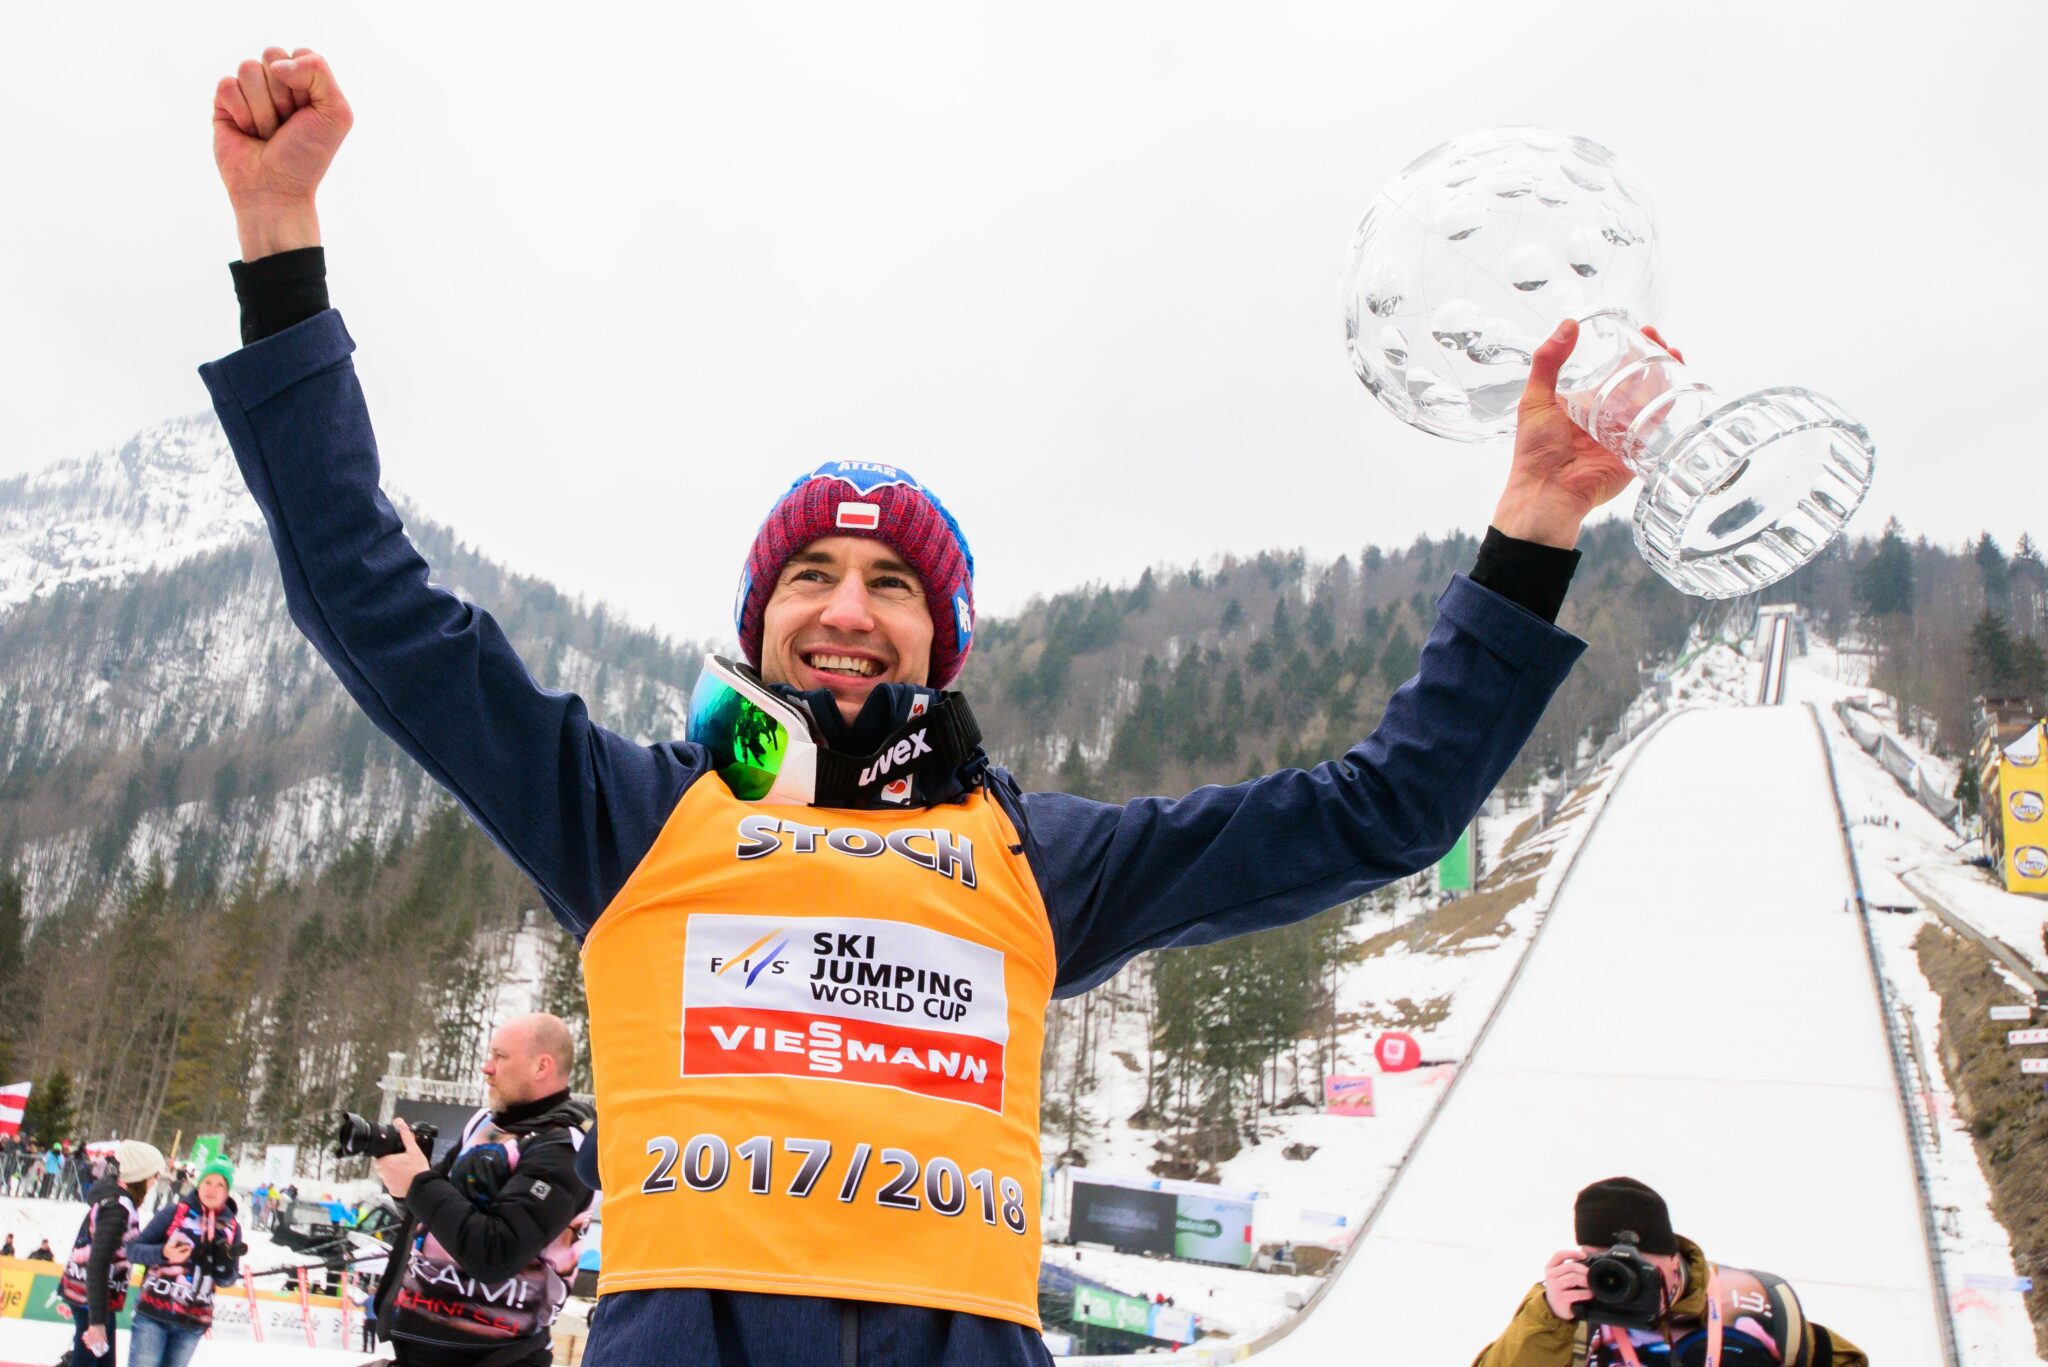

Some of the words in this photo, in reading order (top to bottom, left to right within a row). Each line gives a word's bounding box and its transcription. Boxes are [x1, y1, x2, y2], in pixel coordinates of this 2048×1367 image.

[837, 461, 897, 478] ATLAS
[858, 727, 933, 787] uvex
[735, 814, 978, 889] STOCH
[812, 931, 876, 960] SKI
[810, 958, 973, 1003] JUMPING
[810, 981, 915, 1014] WORLD
[923, 997, 968, 1023] CUP
[709, 1020, 989, 1085] VIESSMANN
[641, 1133, 1027, 1235] 2017/2018
